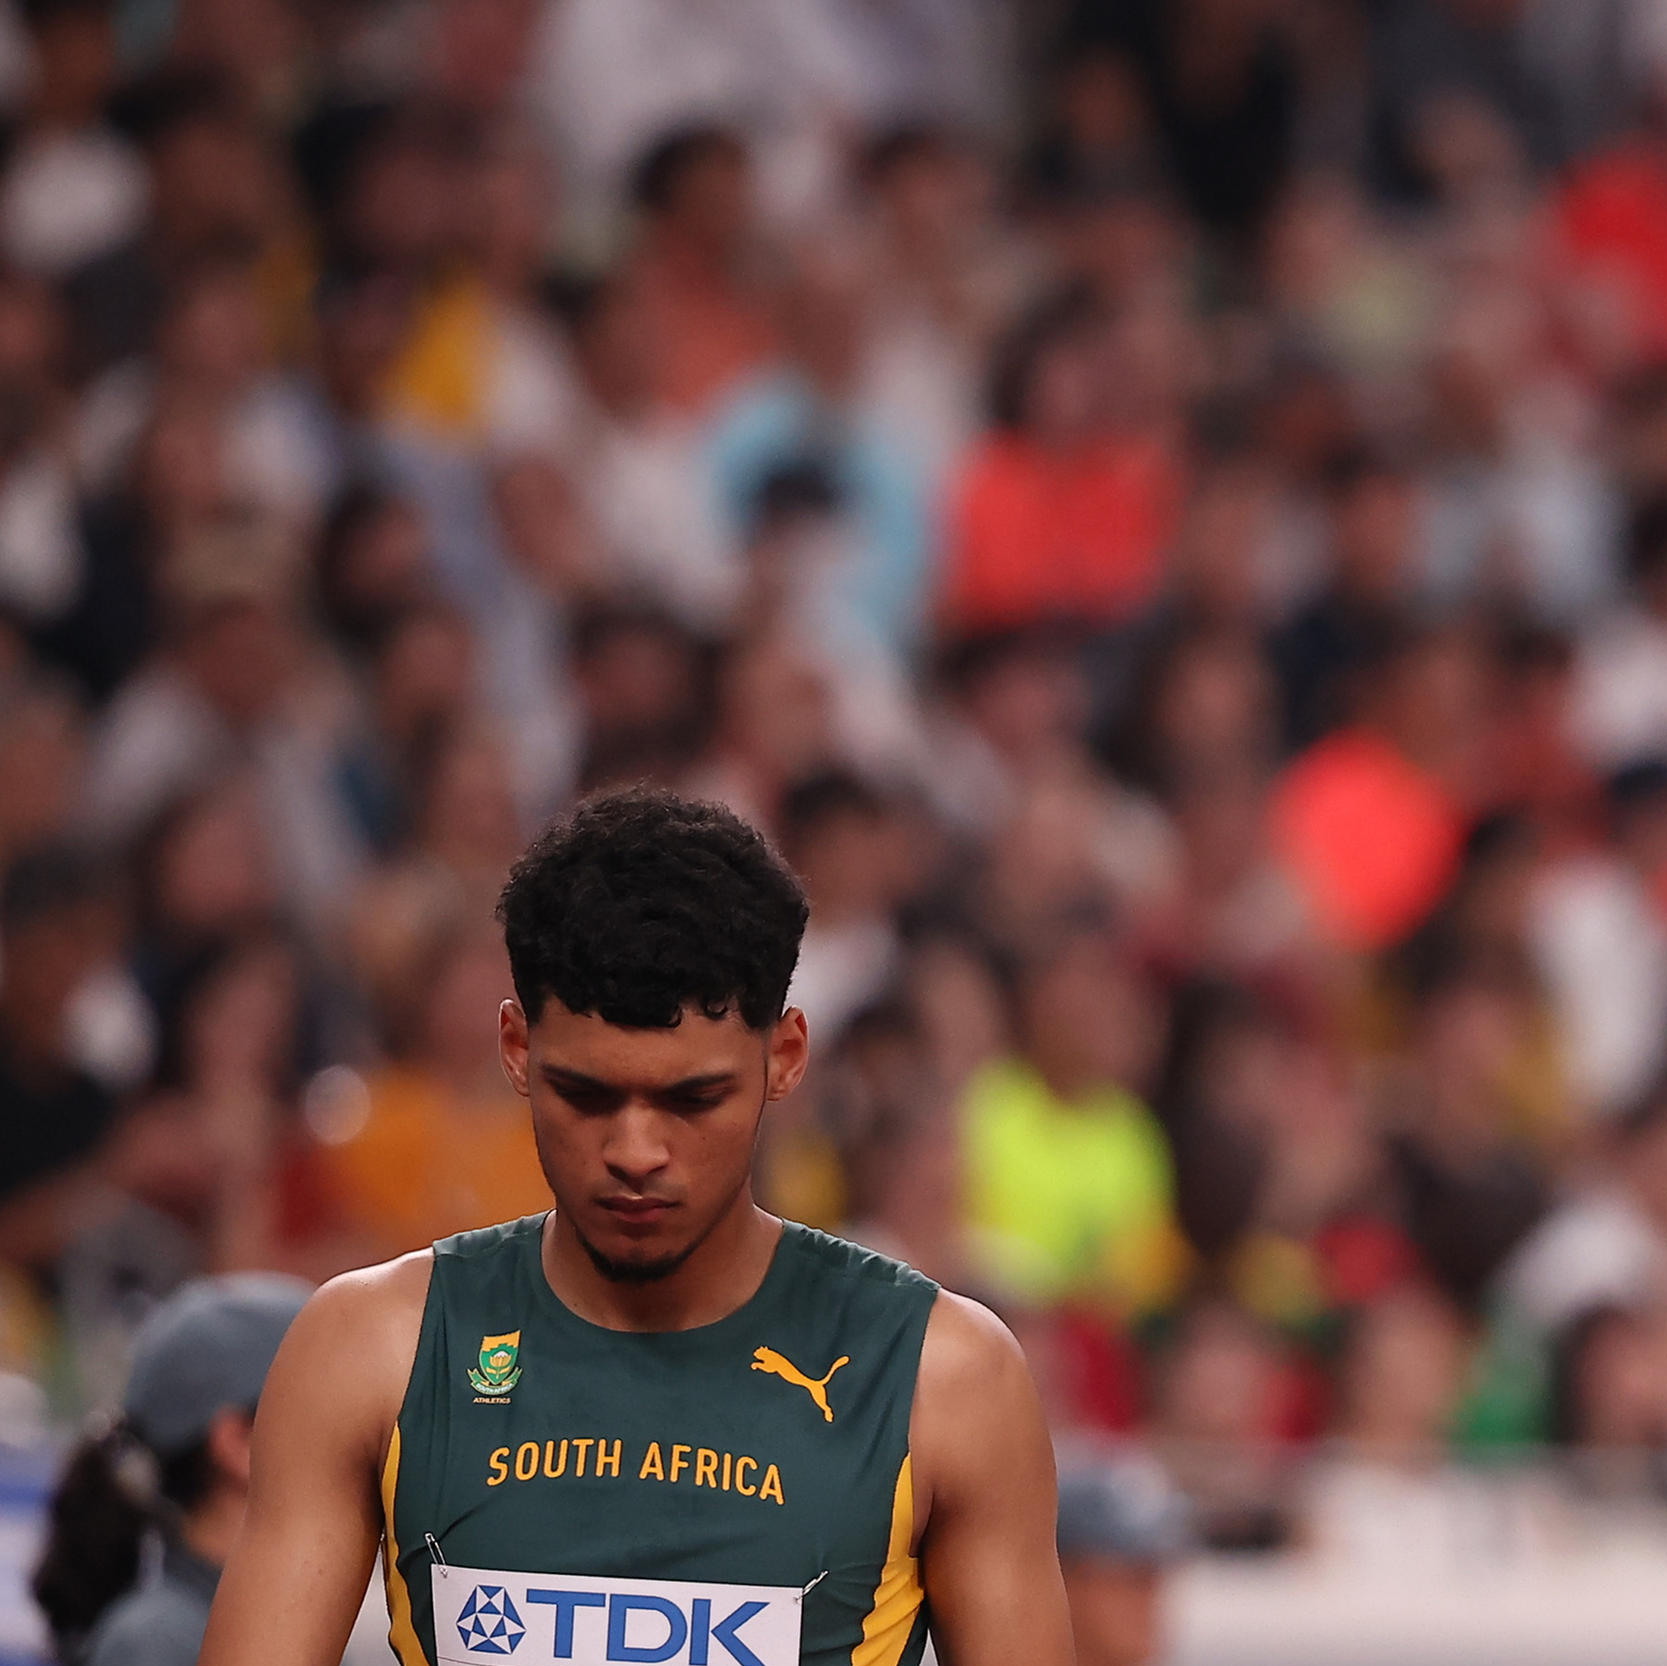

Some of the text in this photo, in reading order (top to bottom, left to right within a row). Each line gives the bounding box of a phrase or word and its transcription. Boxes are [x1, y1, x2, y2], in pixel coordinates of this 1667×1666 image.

[473, 1397, 512, 1405] ATHLETICS
[486, 1438, 785, 1506] SOUTH AFRICA
